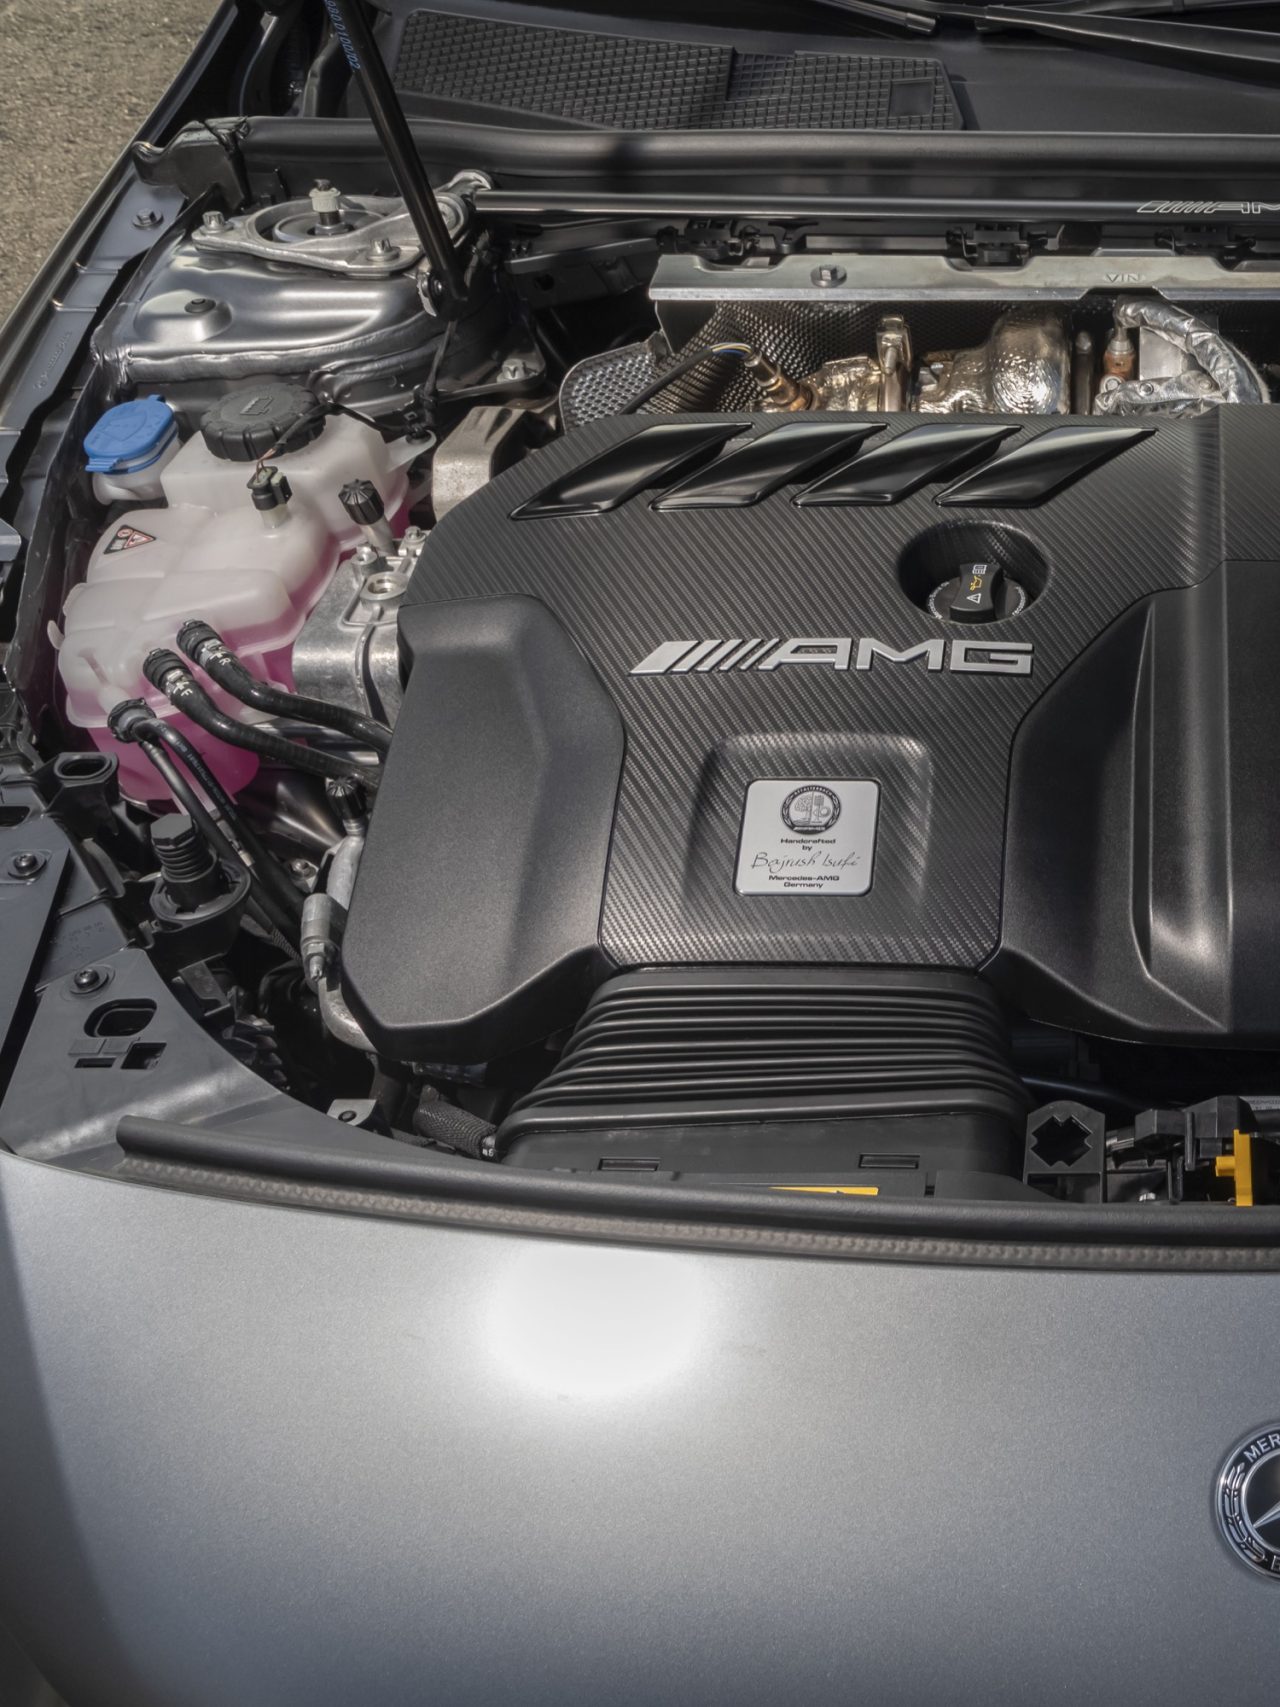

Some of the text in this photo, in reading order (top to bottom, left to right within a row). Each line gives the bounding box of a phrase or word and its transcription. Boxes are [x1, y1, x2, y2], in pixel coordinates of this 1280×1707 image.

[757, 637, 1034, 674] AMG
[802, 844, 813, 852] by
[768, 874, 840, 882] Mercedes-AMG
[783, 881, 824, 889] Germany
